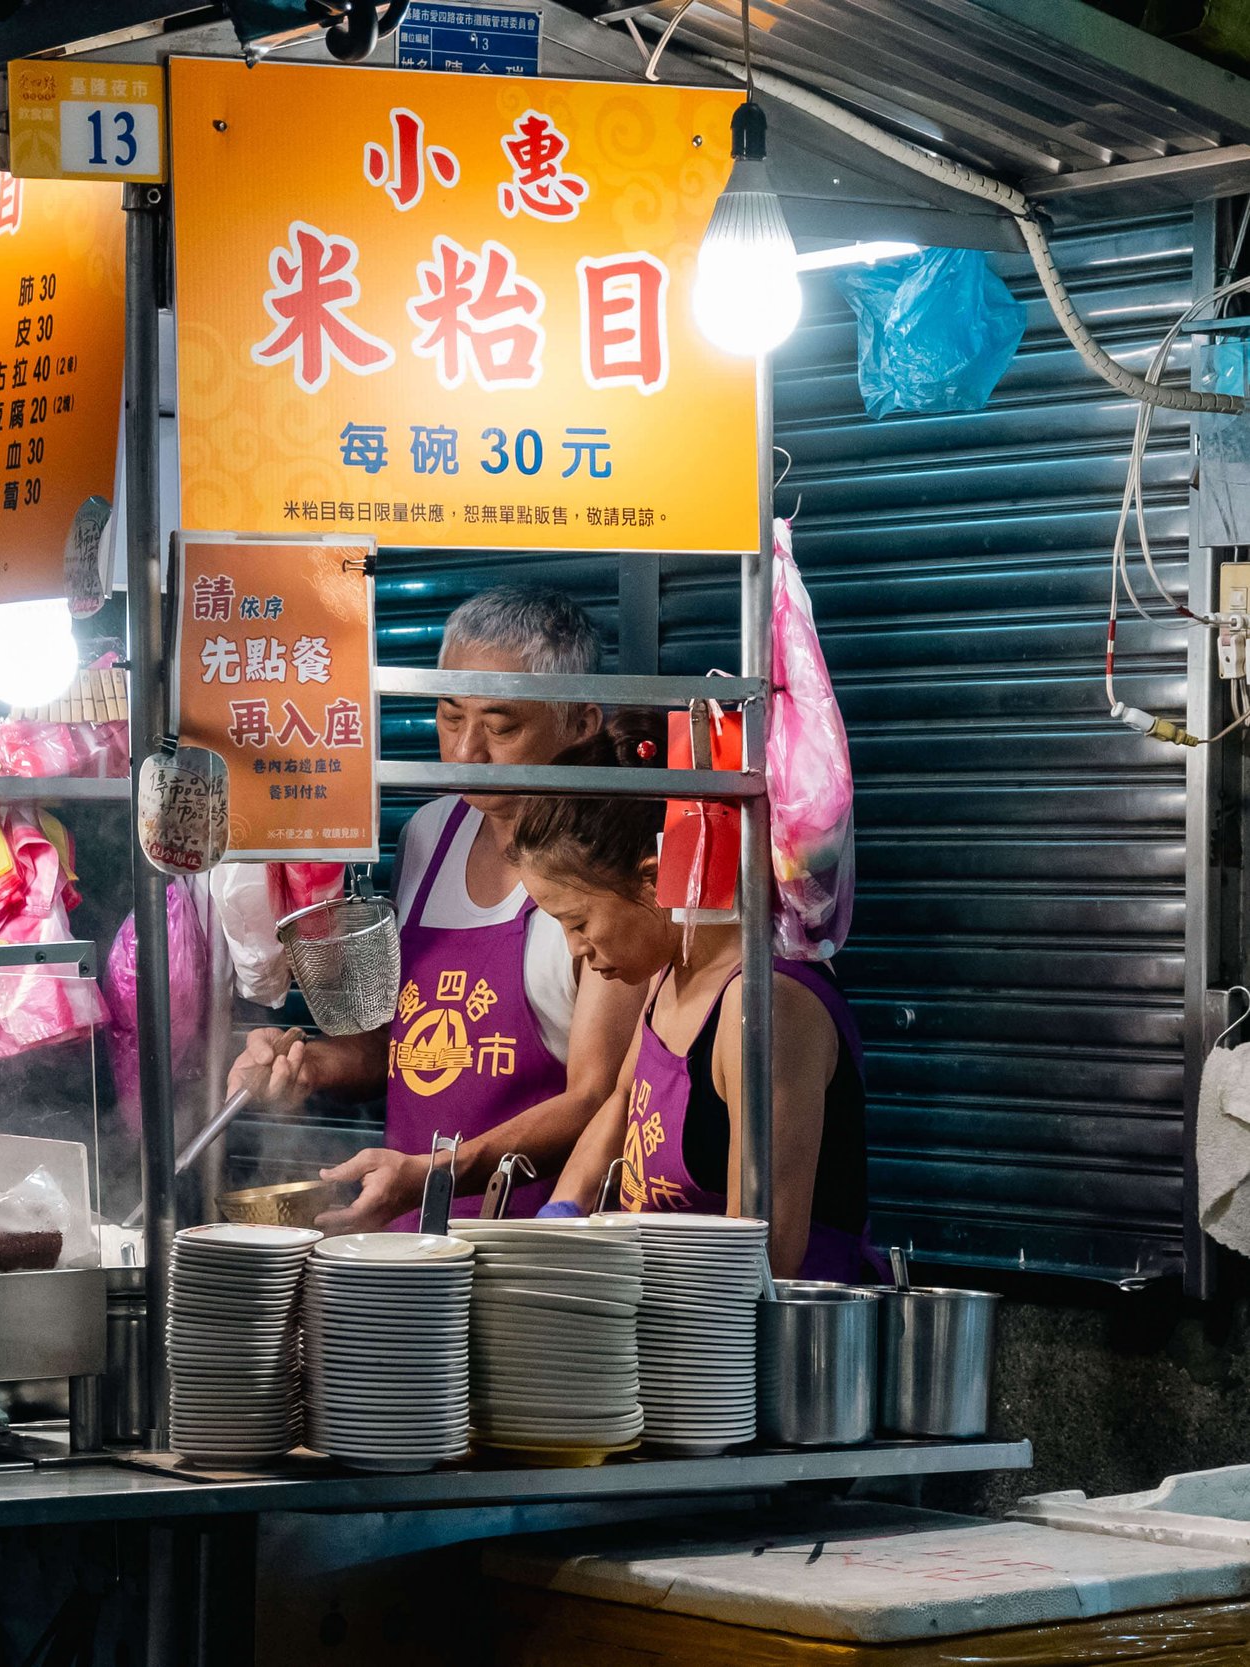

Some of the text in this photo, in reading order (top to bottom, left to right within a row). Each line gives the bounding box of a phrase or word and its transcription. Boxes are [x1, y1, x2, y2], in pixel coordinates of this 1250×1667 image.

[70, 77, 148, 98] 基隆夜市
[87, 110, 138, 166] 13
[364, 108, 589, 222] 小惠
[39, 273, 56, 301] 30
[36, 314, 53, 343] 30
[33, 355, 50, 383] 40
[30, 396, 47, 424] 20
[27, 437, 44, 464] 30
[24, 478, 41, 506] 30
[200, 635, 332, 684] 先點餐
[228, 697, 364, 748] 再入座
[269, 785, 327, 800] 餐到付款
[398, 970, 498, 1024] 愛四路
